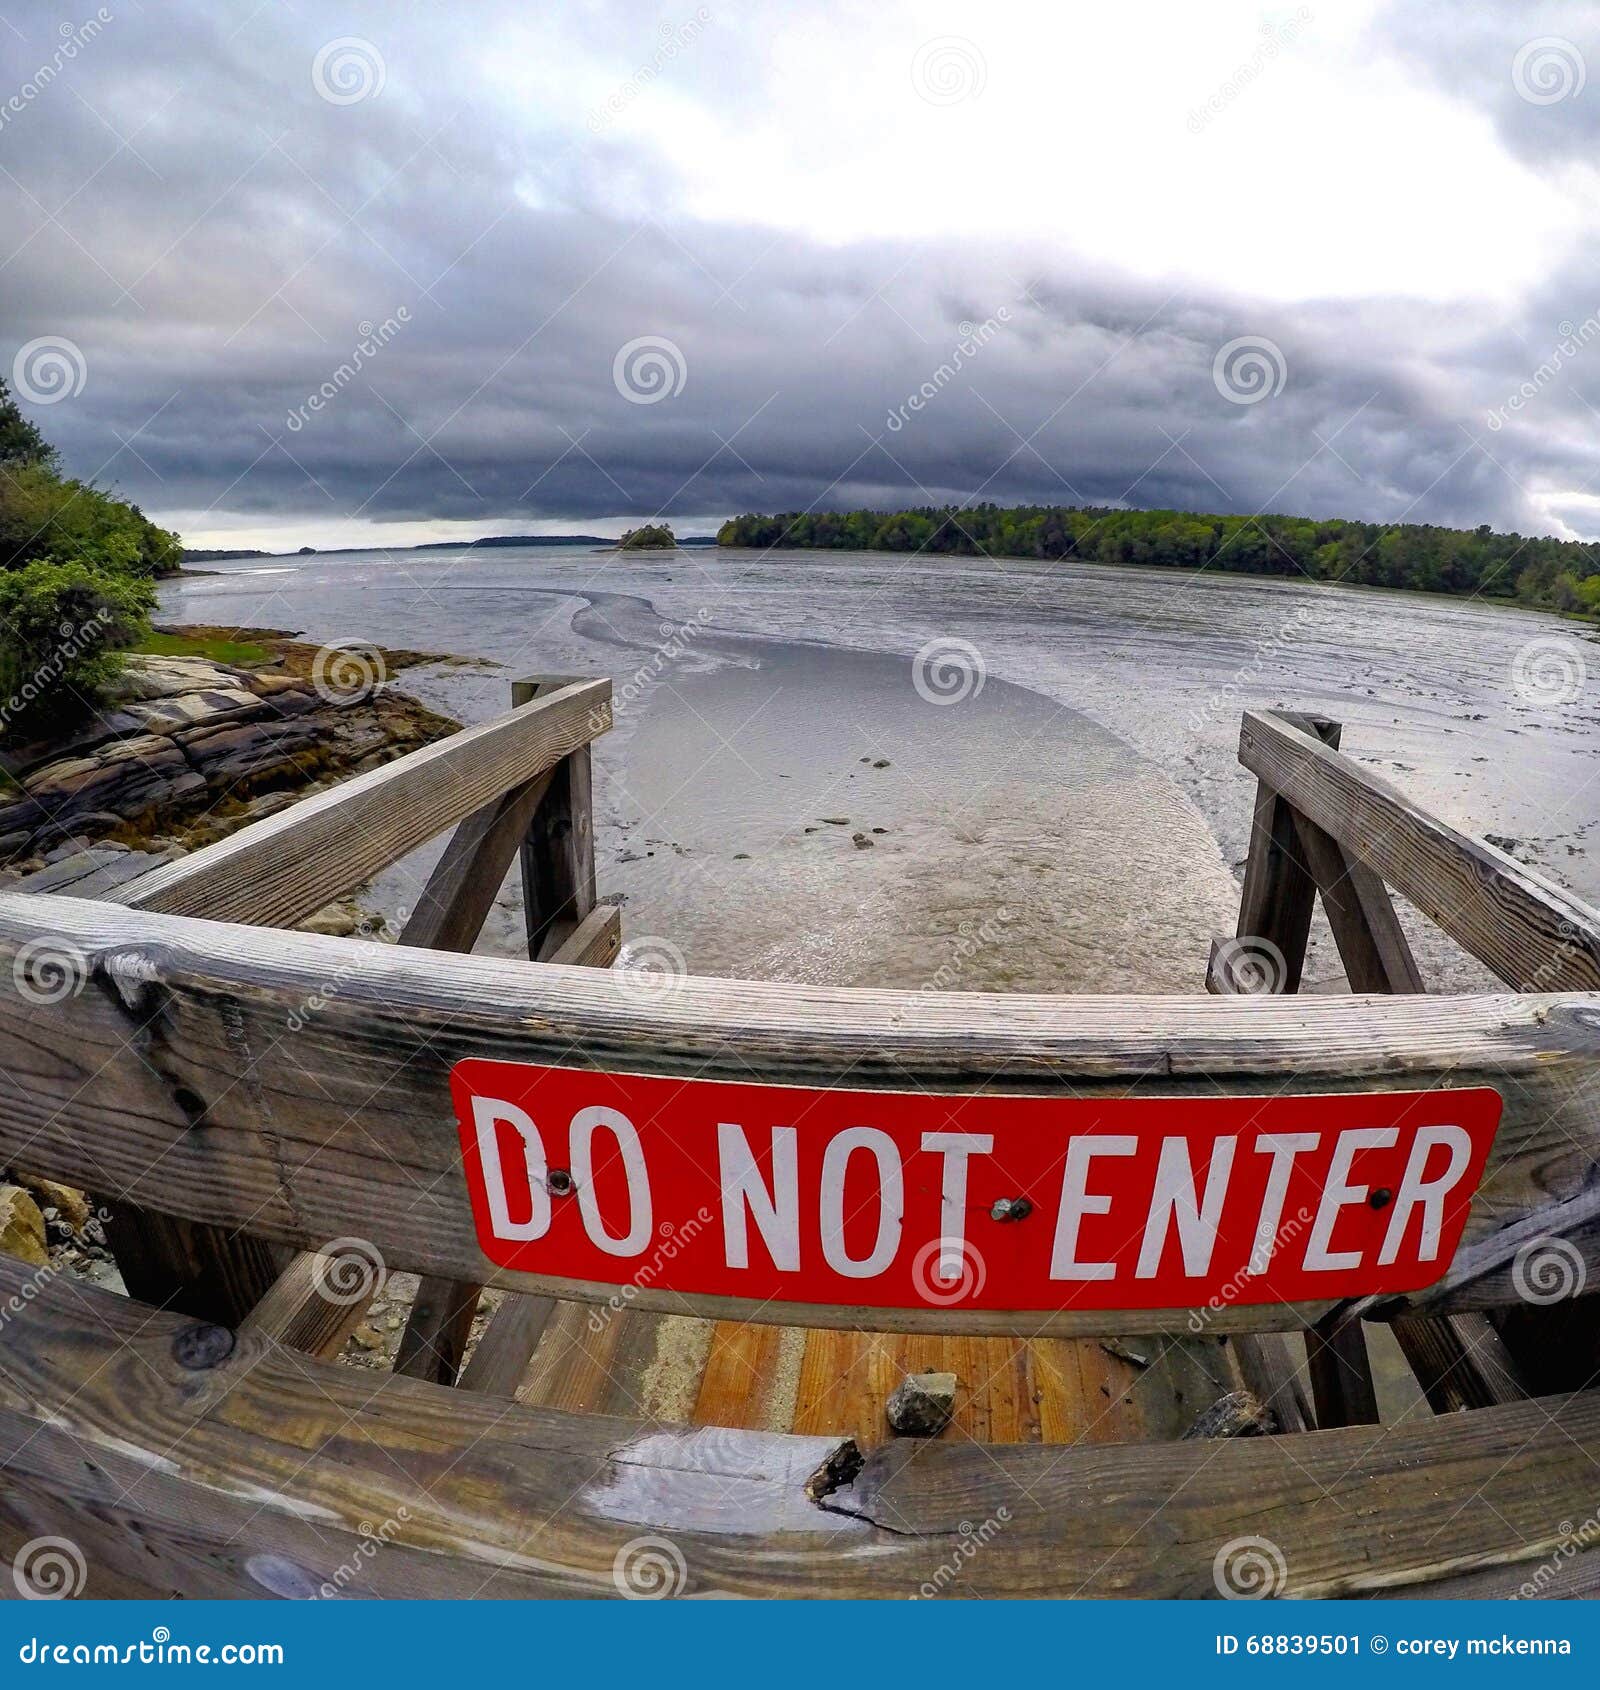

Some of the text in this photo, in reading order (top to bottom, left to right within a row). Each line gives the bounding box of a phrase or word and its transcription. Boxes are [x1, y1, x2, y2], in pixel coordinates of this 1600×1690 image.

[470, 1094, 1473, 1282] DO NOT ENTER
